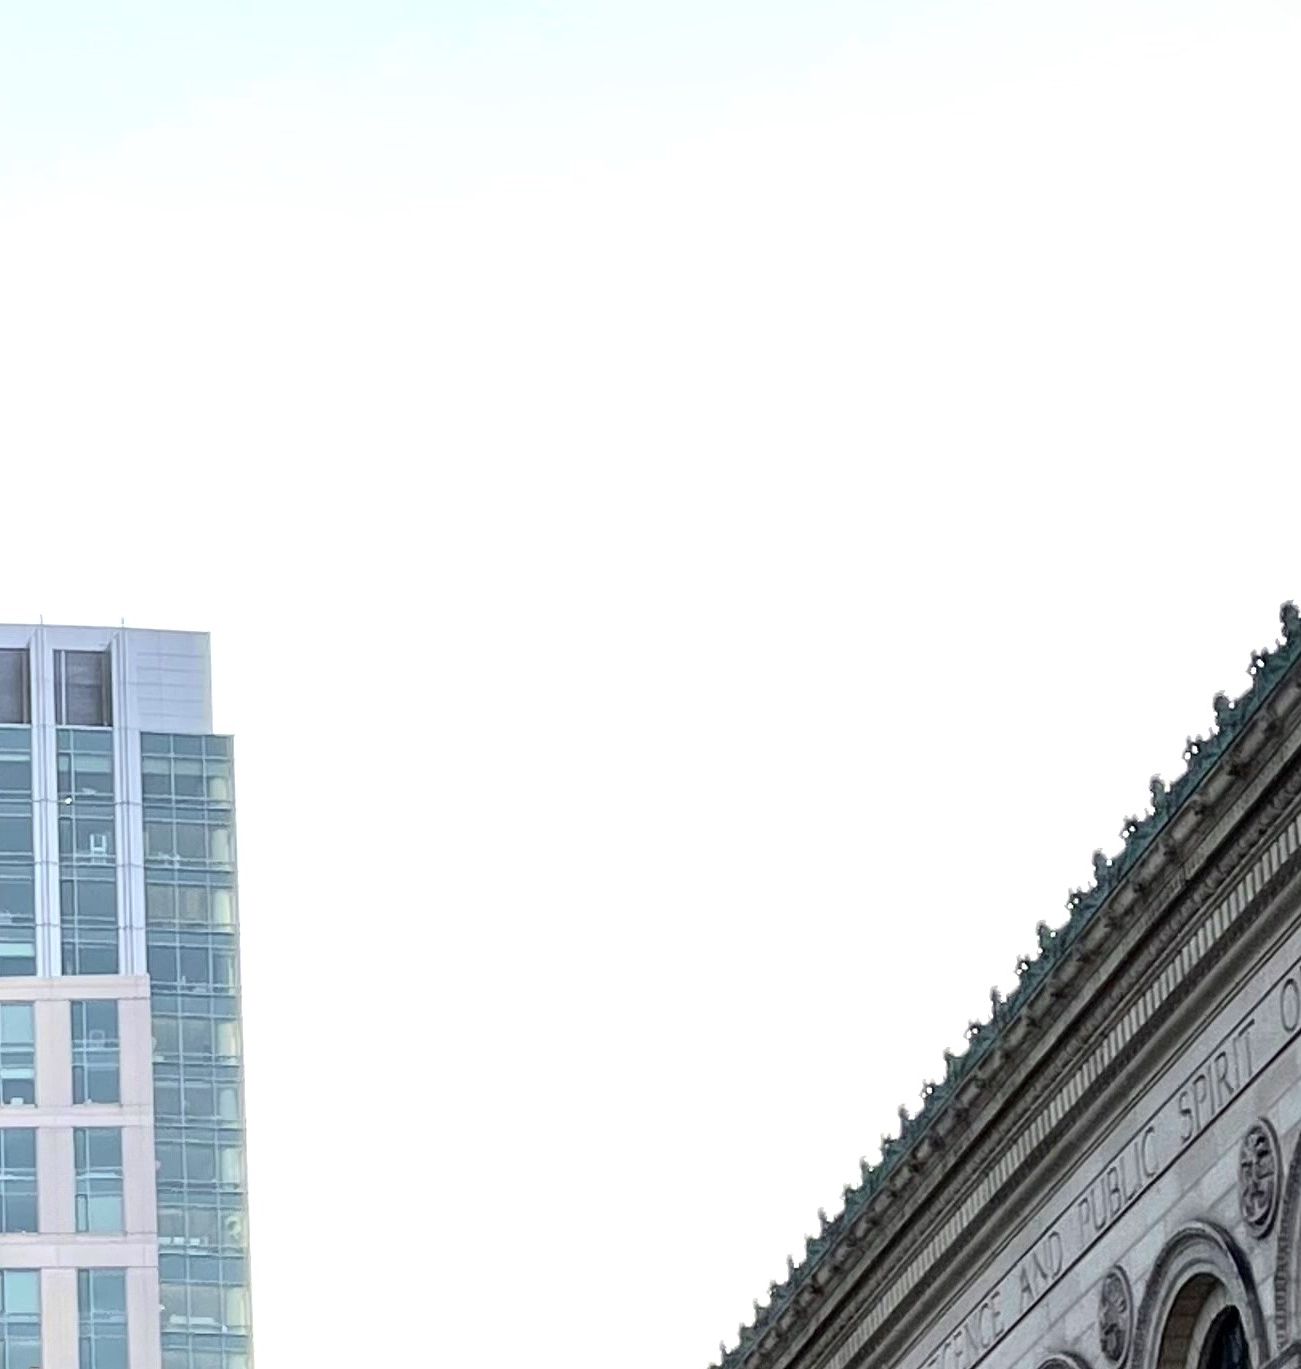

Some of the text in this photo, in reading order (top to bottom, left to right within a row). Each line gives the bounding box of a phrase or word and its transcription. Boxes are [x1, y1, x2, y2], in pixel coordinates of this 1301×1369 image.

[1019, 1231, 1063, 1316] AND
[1078, 1126, 1159, 1250] PUBLIC
[1178, 1018, 1255, 1144] SPIRIT
[1280, 966, 1301, 1034] O
